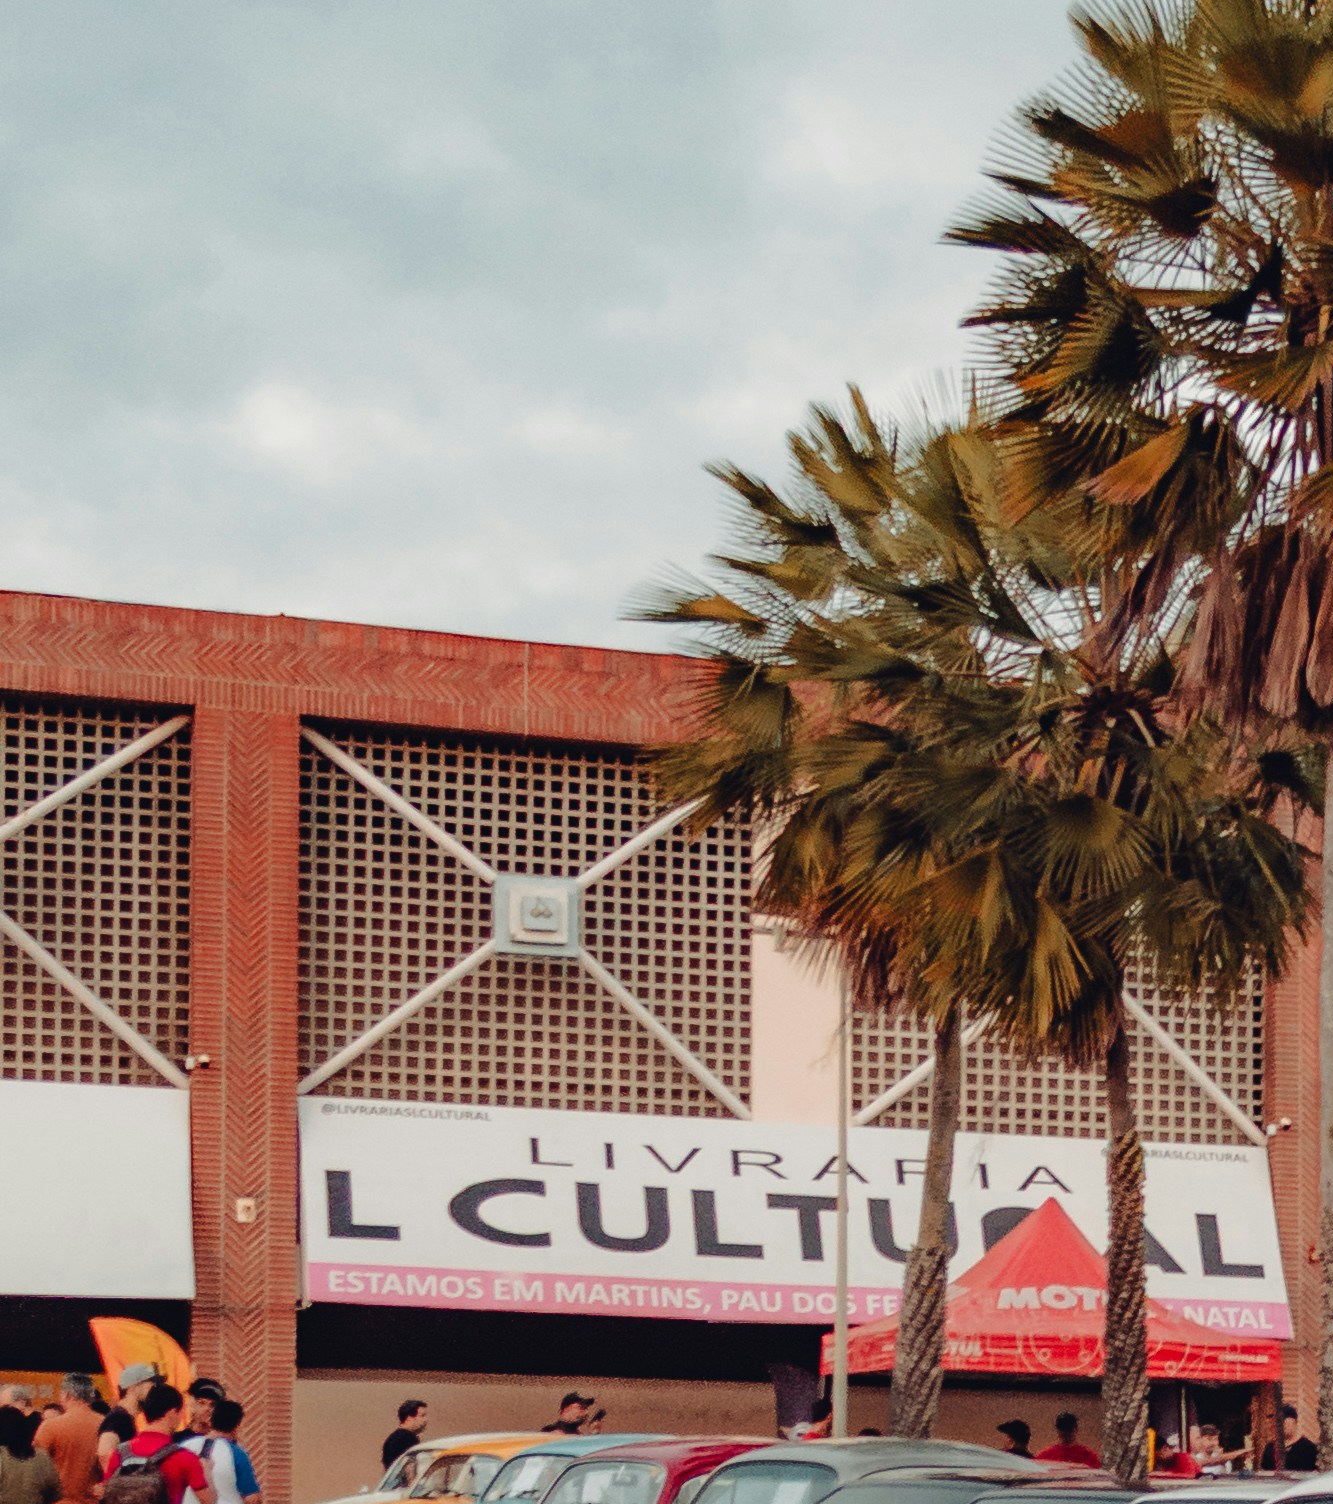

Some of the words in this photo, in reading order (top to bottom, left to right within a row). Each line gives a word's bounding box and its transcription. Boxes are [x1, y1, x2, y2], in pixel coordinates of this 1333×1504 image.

[327, 1269, 484, 1299] ESTAMOS
[493, 1278, 545, 1303] EM
[553, 1281, 713, 1315] MARTINS,
[720, 1290, 787, 1313] PAU
[865, 1296, 900, 1317] FE
[1183, 1305, 1274, 1331] NATAL
[997, 1286, 1109, 1311] MOT
